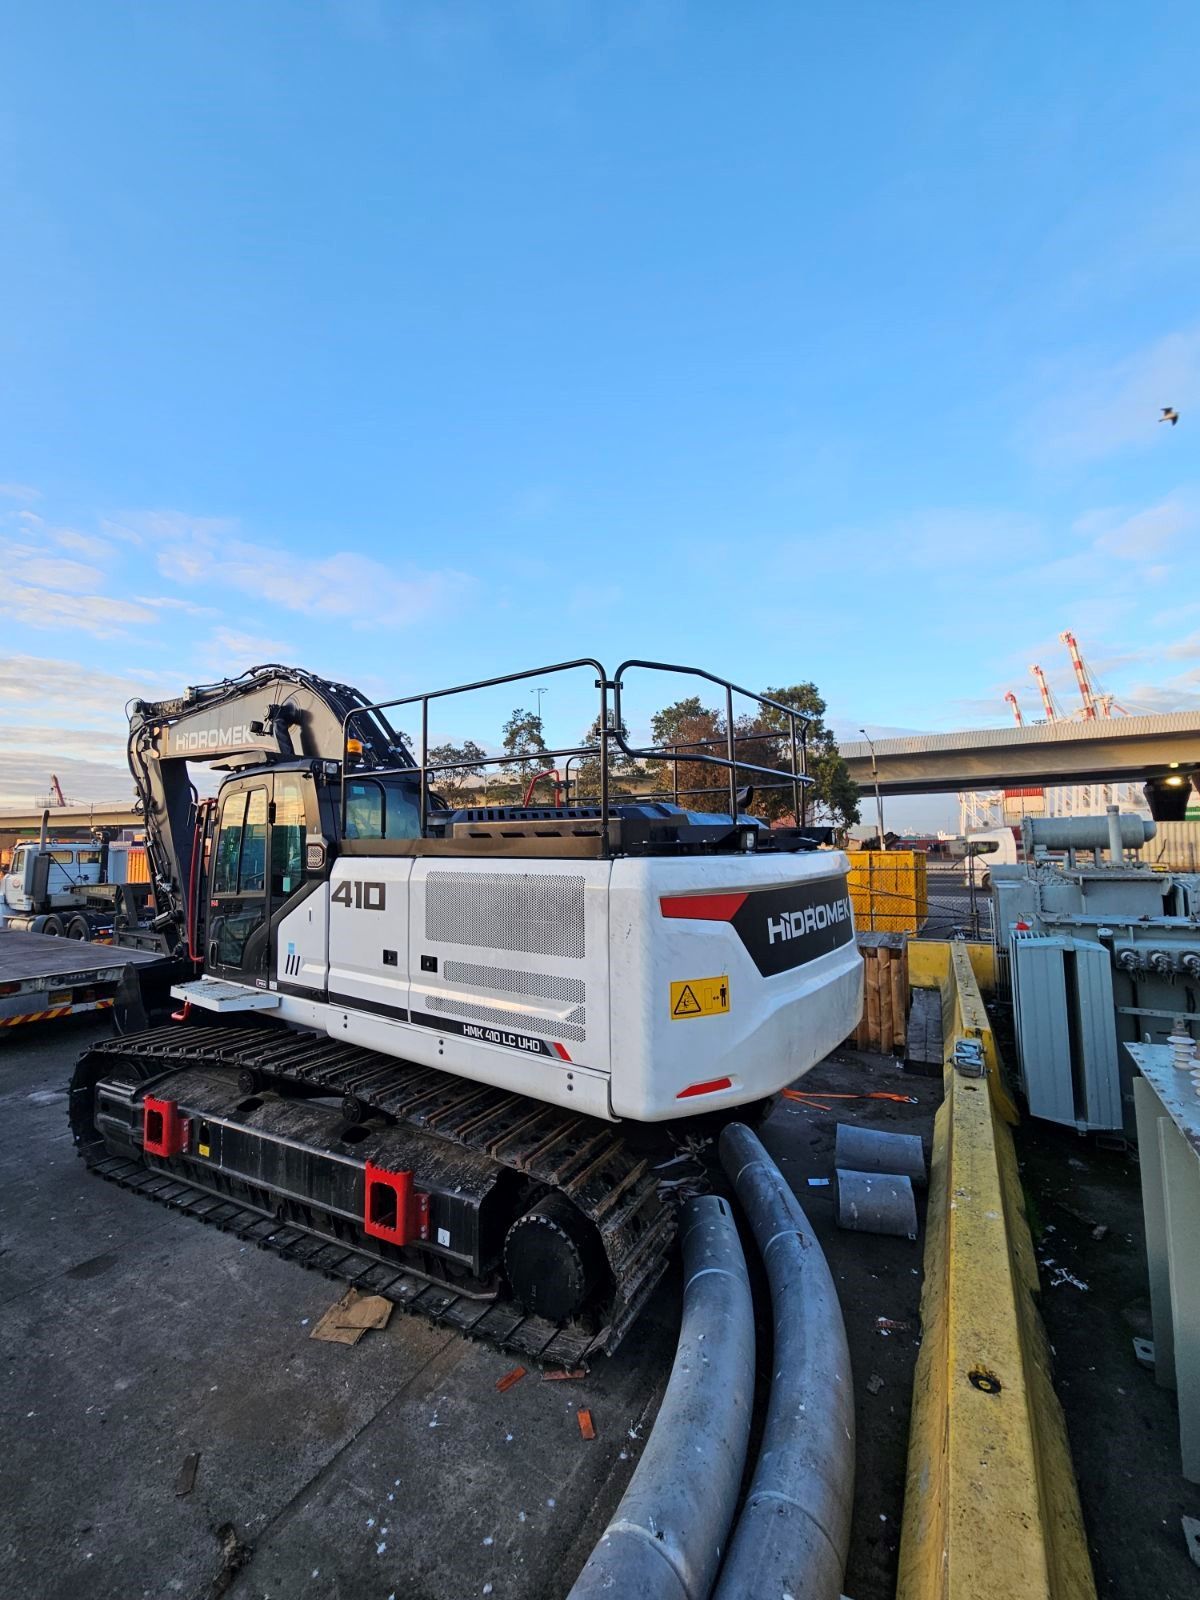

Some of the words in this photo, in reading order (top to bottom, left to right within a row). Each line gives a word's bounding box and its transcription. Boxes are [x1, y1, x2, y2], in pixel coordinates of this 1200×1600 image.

[331, 880, 386, 912] 410
[463, 1024, 484, 1039] HMK
[485, 1030, 500, 1043] 410
[502, 1033, 516, 1046] LC
[518, 1037, 540, 1052] UHD
